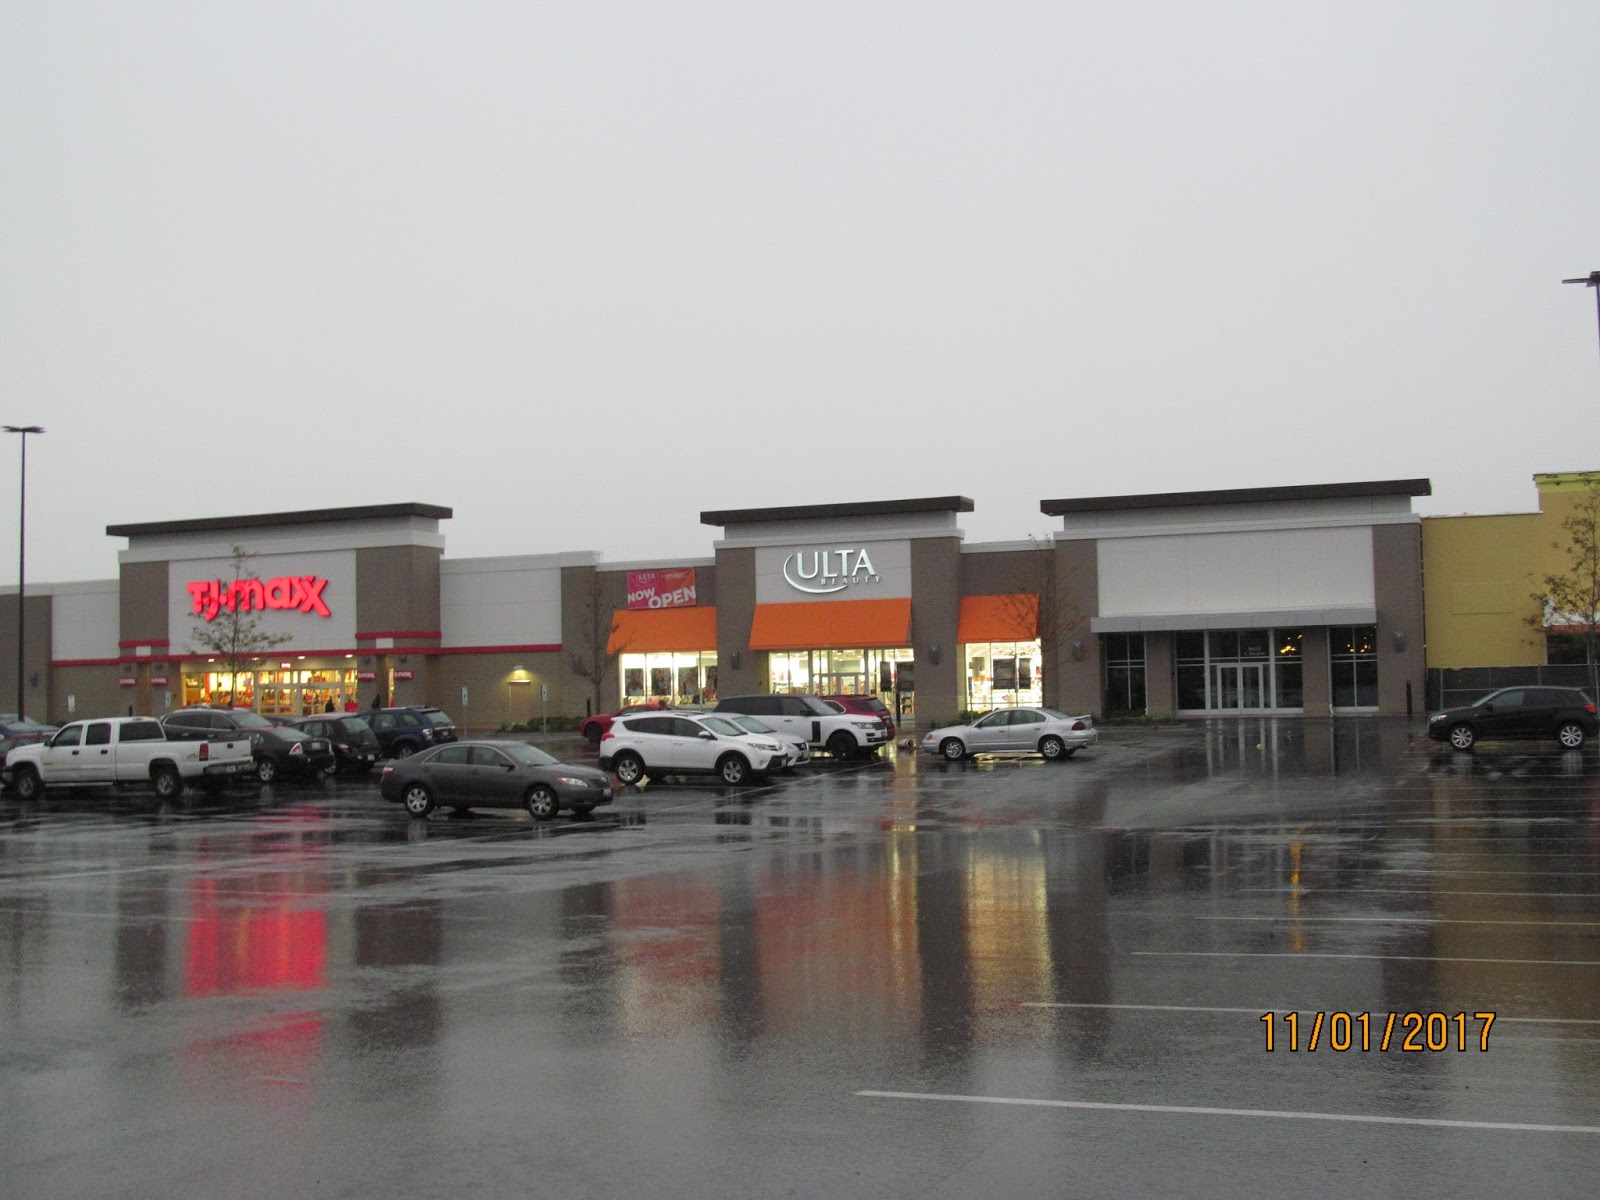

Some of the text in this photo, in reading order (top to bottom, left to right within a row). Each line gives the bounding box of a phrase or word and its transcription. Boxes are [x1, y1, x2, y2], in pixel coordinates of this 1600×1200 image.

[797, 549, 876, 579] ULTA
[820, 576, 880, 585] BEAUTY
[627, 585, 697, 609] NOW OPEN
